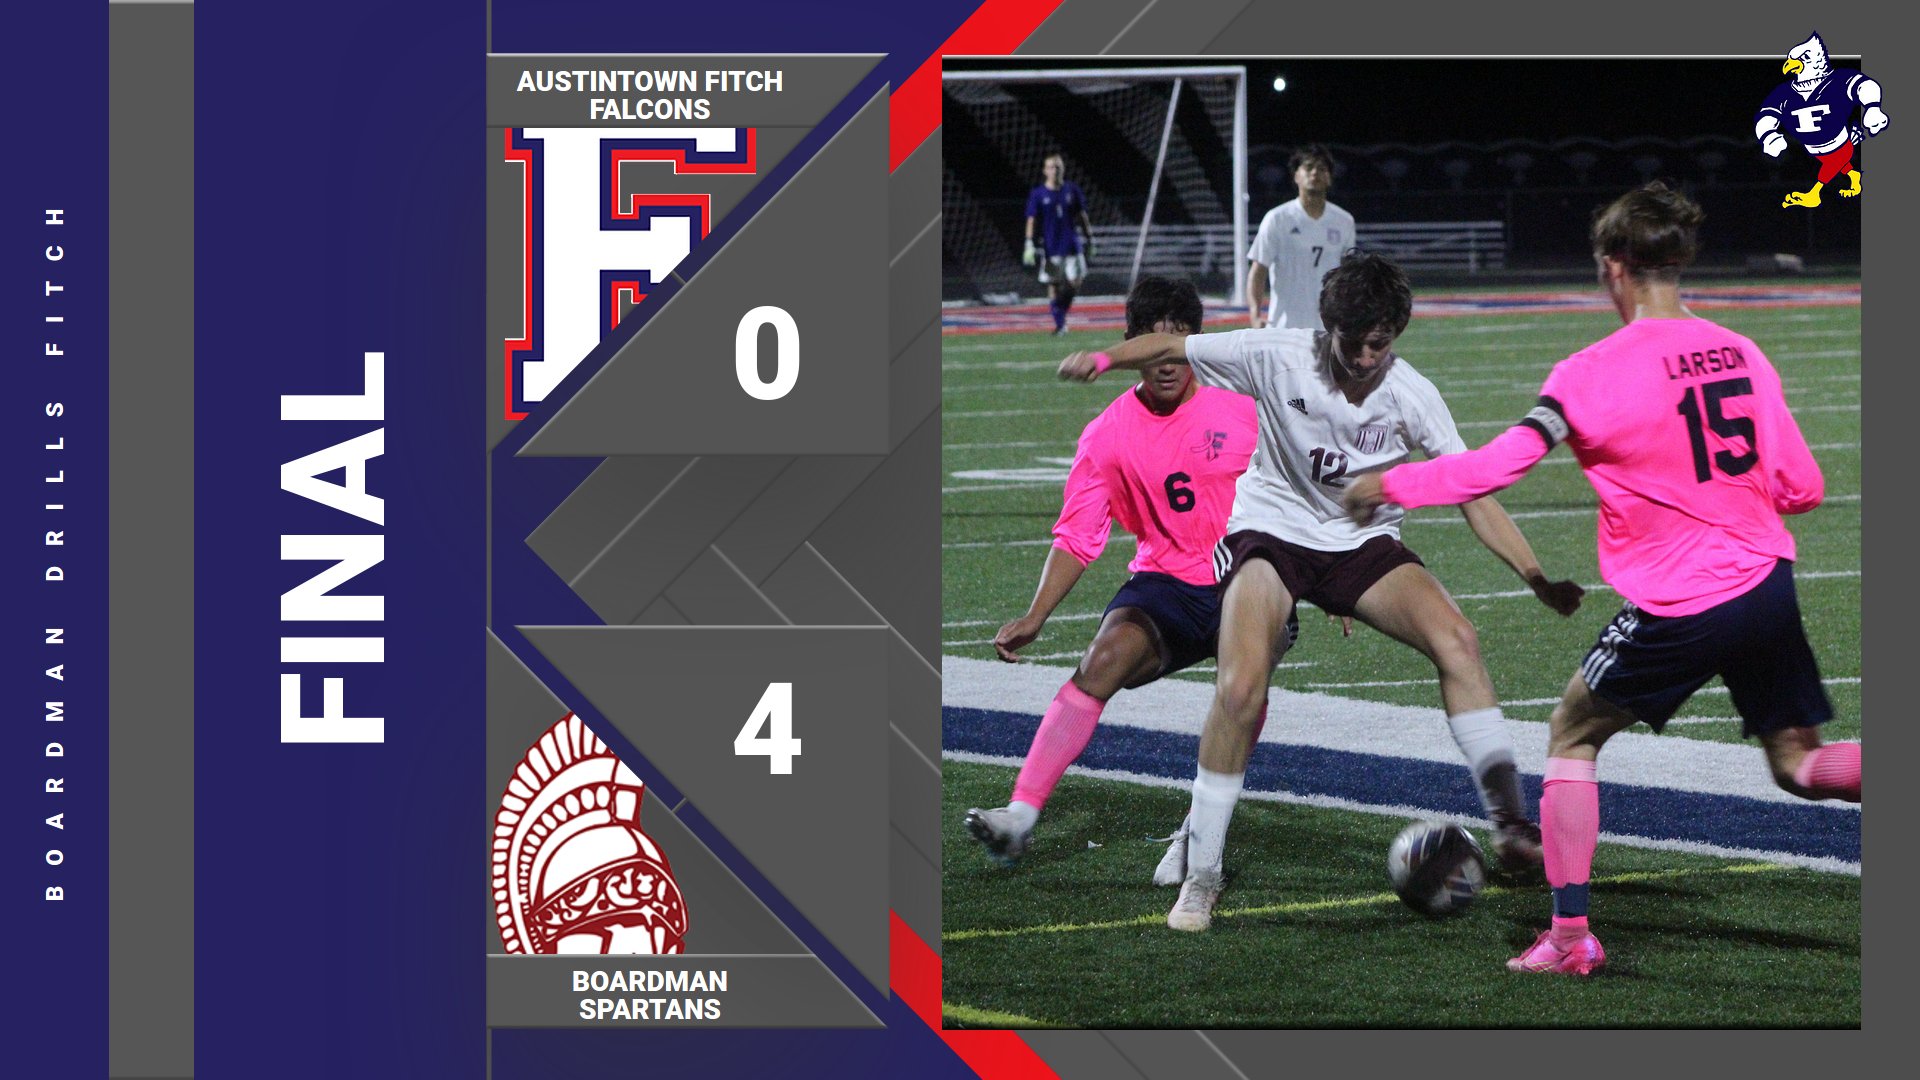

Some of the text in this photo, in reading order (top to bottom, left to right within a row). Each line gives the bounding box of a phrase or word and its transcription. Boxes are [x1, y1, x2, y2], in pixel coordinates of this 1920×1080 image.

[1312, 246, 1323, 267] 7
[1663, 346, 1748, 380] LARSON
[1677, 377, 1759, 483] 15
[1309, 447, 1348, 488] 12
[1164, 471, 1195, 513] 6
